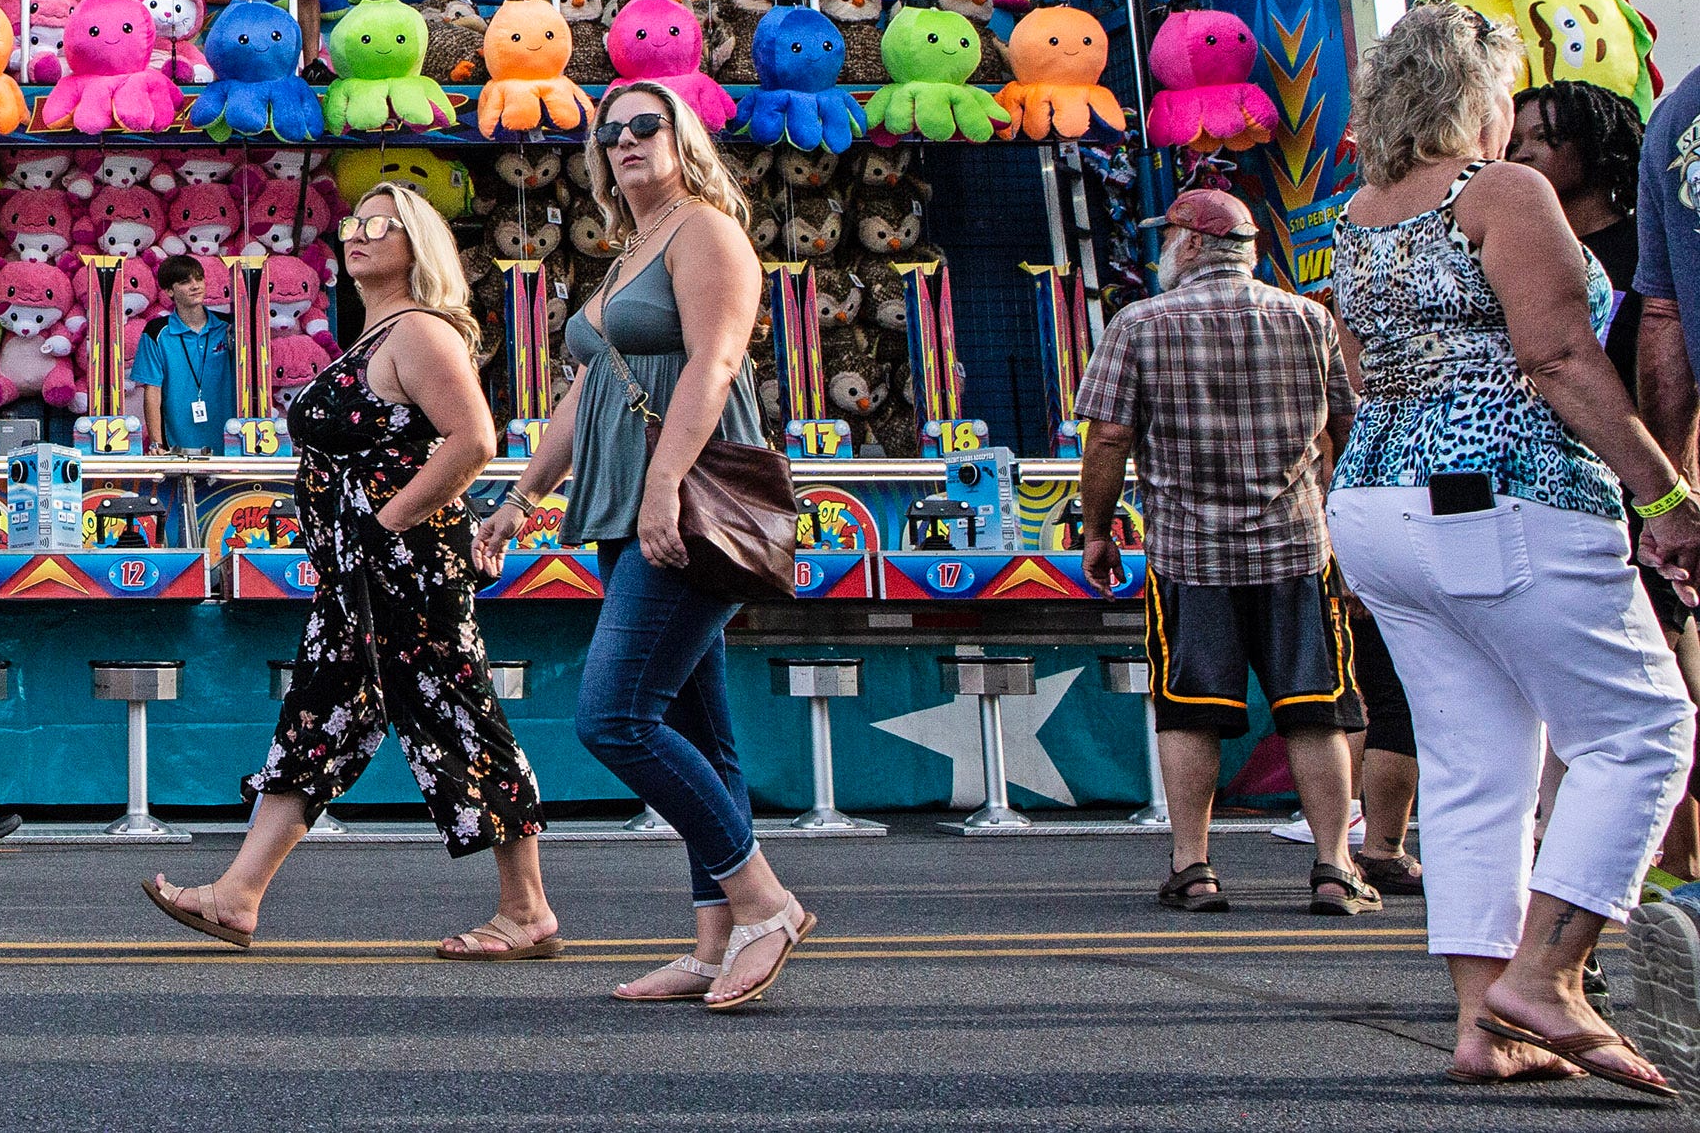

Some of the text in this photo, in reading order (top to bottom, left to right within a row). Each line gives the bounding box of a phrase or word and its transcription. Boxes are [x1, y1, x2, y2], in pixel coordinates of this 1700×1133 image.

[1307, 210, 1325, 227] PER
[1298, 246, 1333, 285] WI
[90, 418, 130, 452] 12
[240, 420, 280, 455] 13
[802, 421, 841, 456] 17
[939, 421, 980, 453] 18
[120, 561, 146, 587] 12
[796, 561, 811, 587] 6
[937, 563, 961, 588] 17
